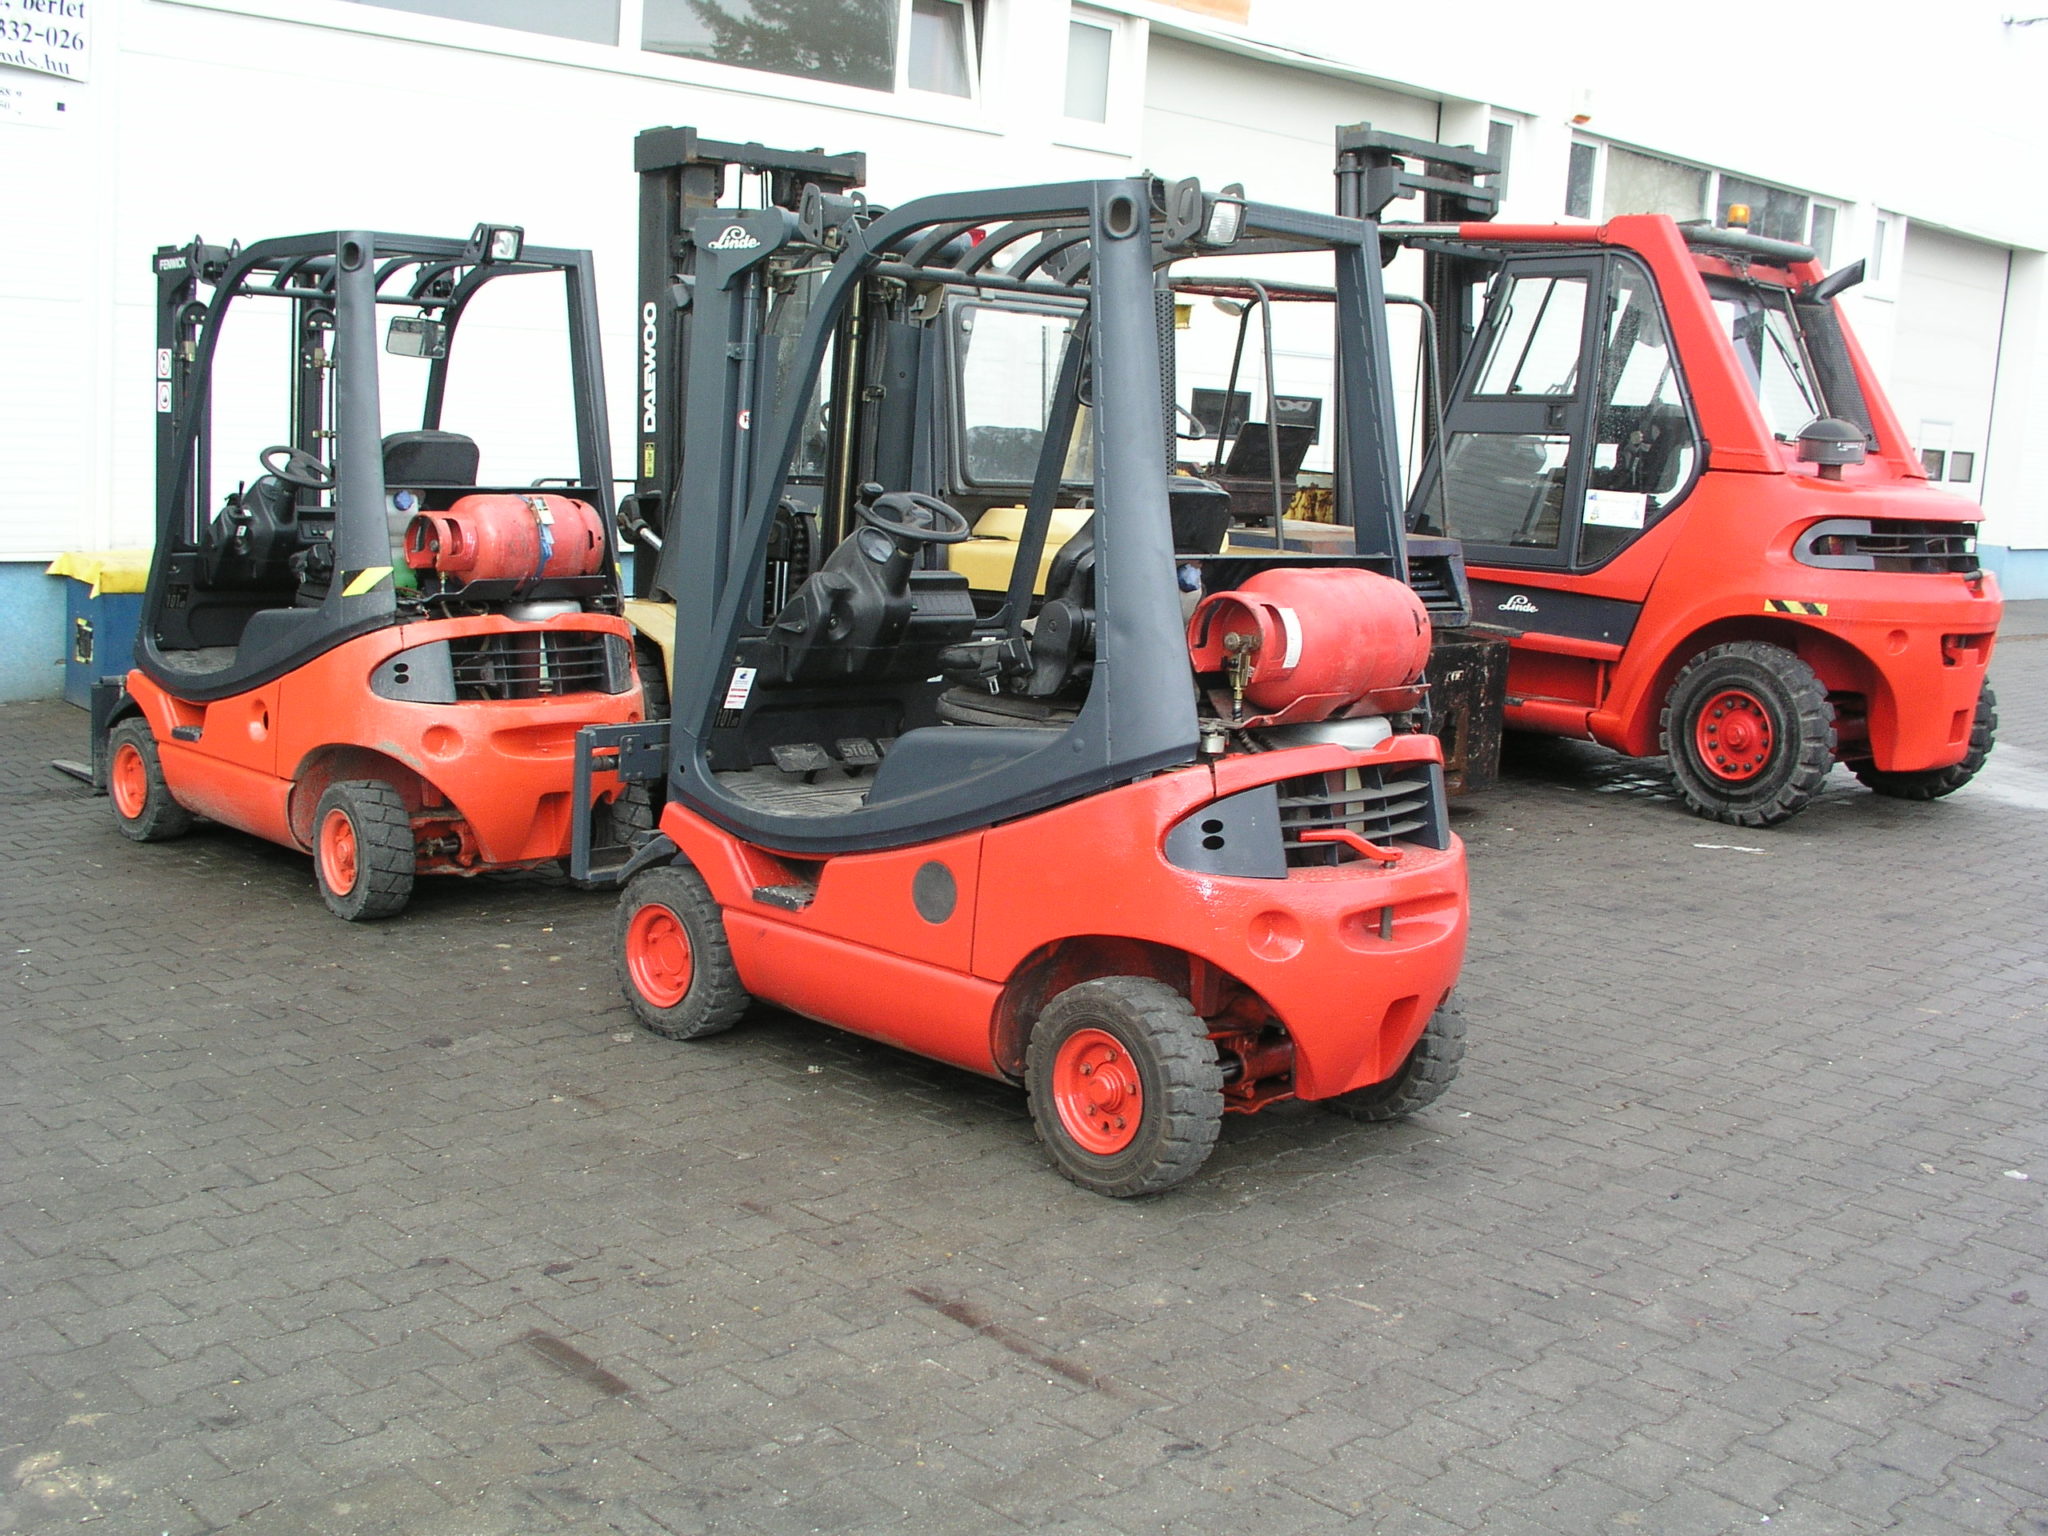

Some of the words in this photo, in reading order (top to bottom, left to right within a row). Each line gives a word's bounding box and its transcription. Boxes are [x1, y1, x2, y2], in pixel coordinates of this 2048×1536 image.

[708, 225, 761, 250] Linde
[643, 301, 657, 433] DAEWOO
[1498, 594, 1539, 613] Linde
